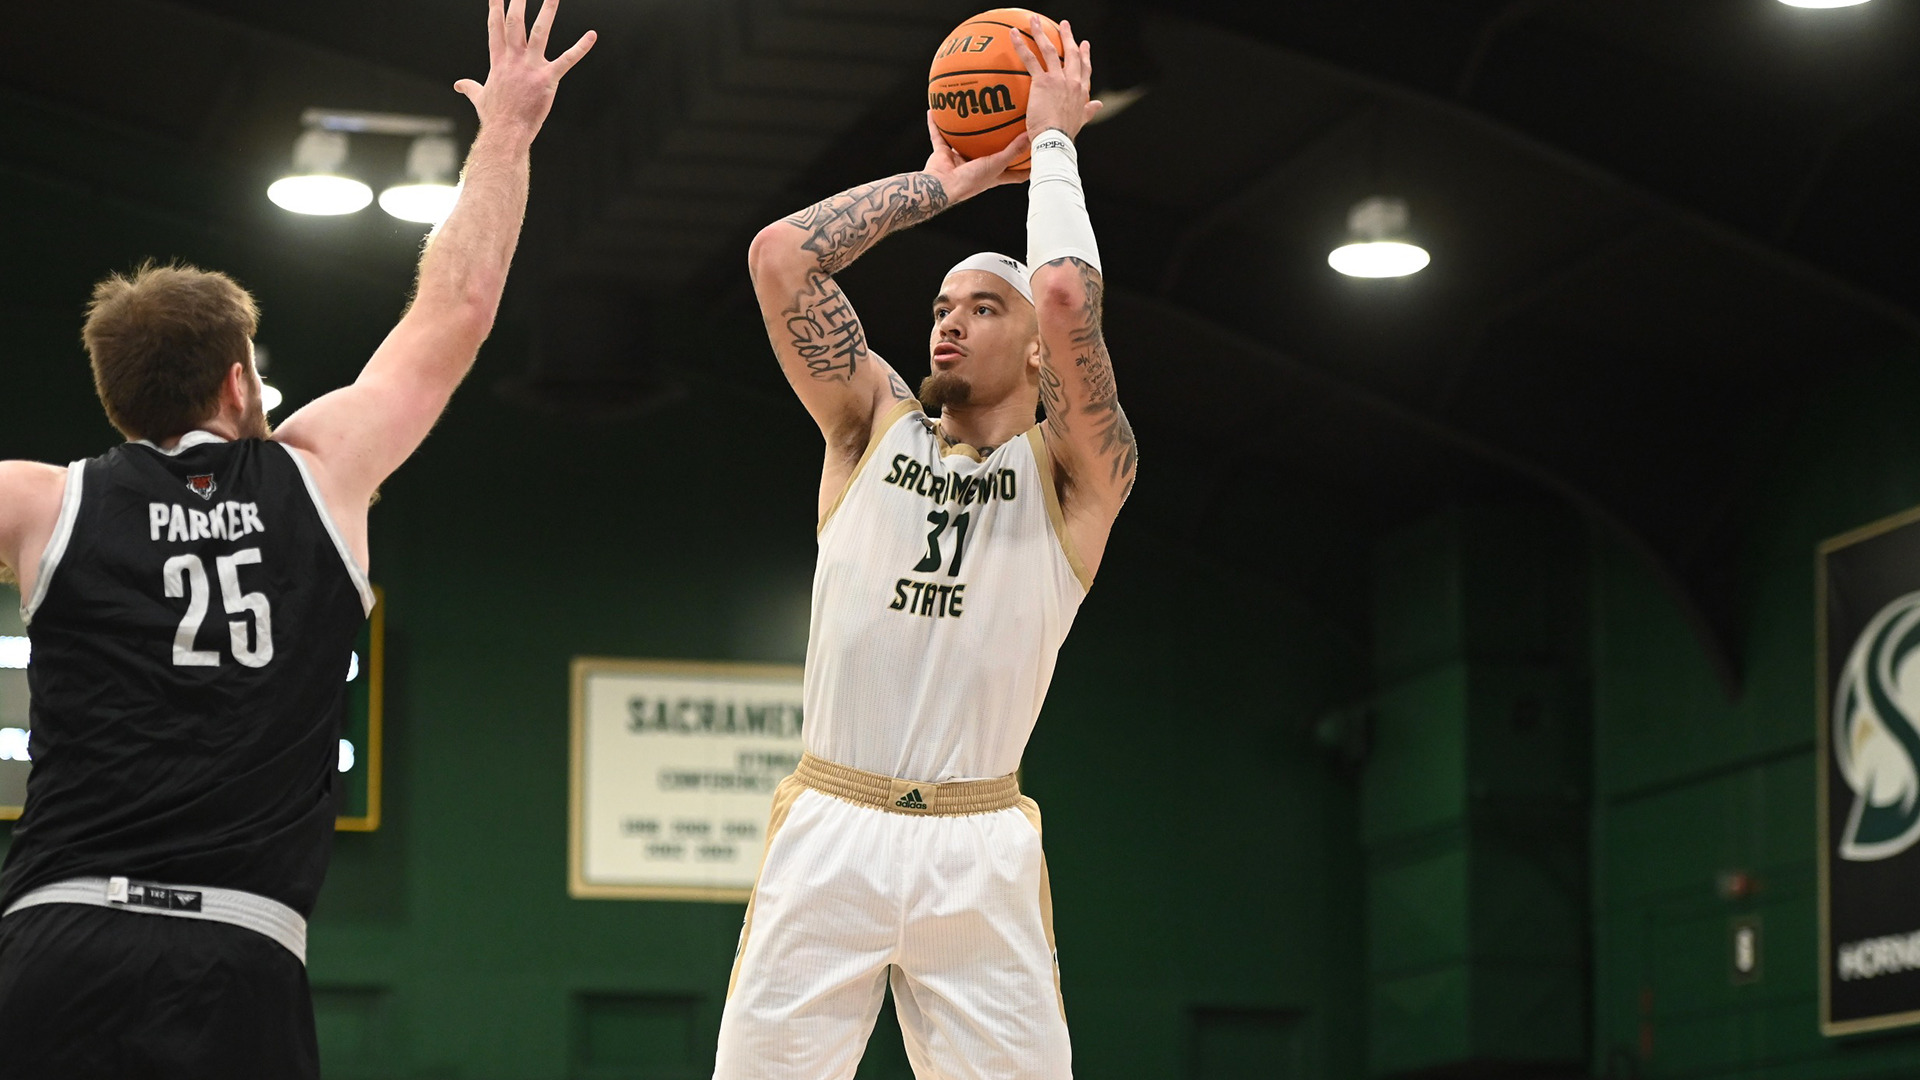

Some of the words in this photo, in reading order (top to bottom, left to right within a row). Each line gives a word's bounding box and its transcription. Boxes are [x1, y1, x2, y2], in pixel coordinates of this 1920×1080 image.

[930, 83, 1016, 119] Wilson
[149, 501, 265, 542] PARKER
[912, 509, 970, 577] 31
[163, 547, 274, 668] 25
[888, 578, 967, 618] STATE
[895, 800, 927, 810] adidas
